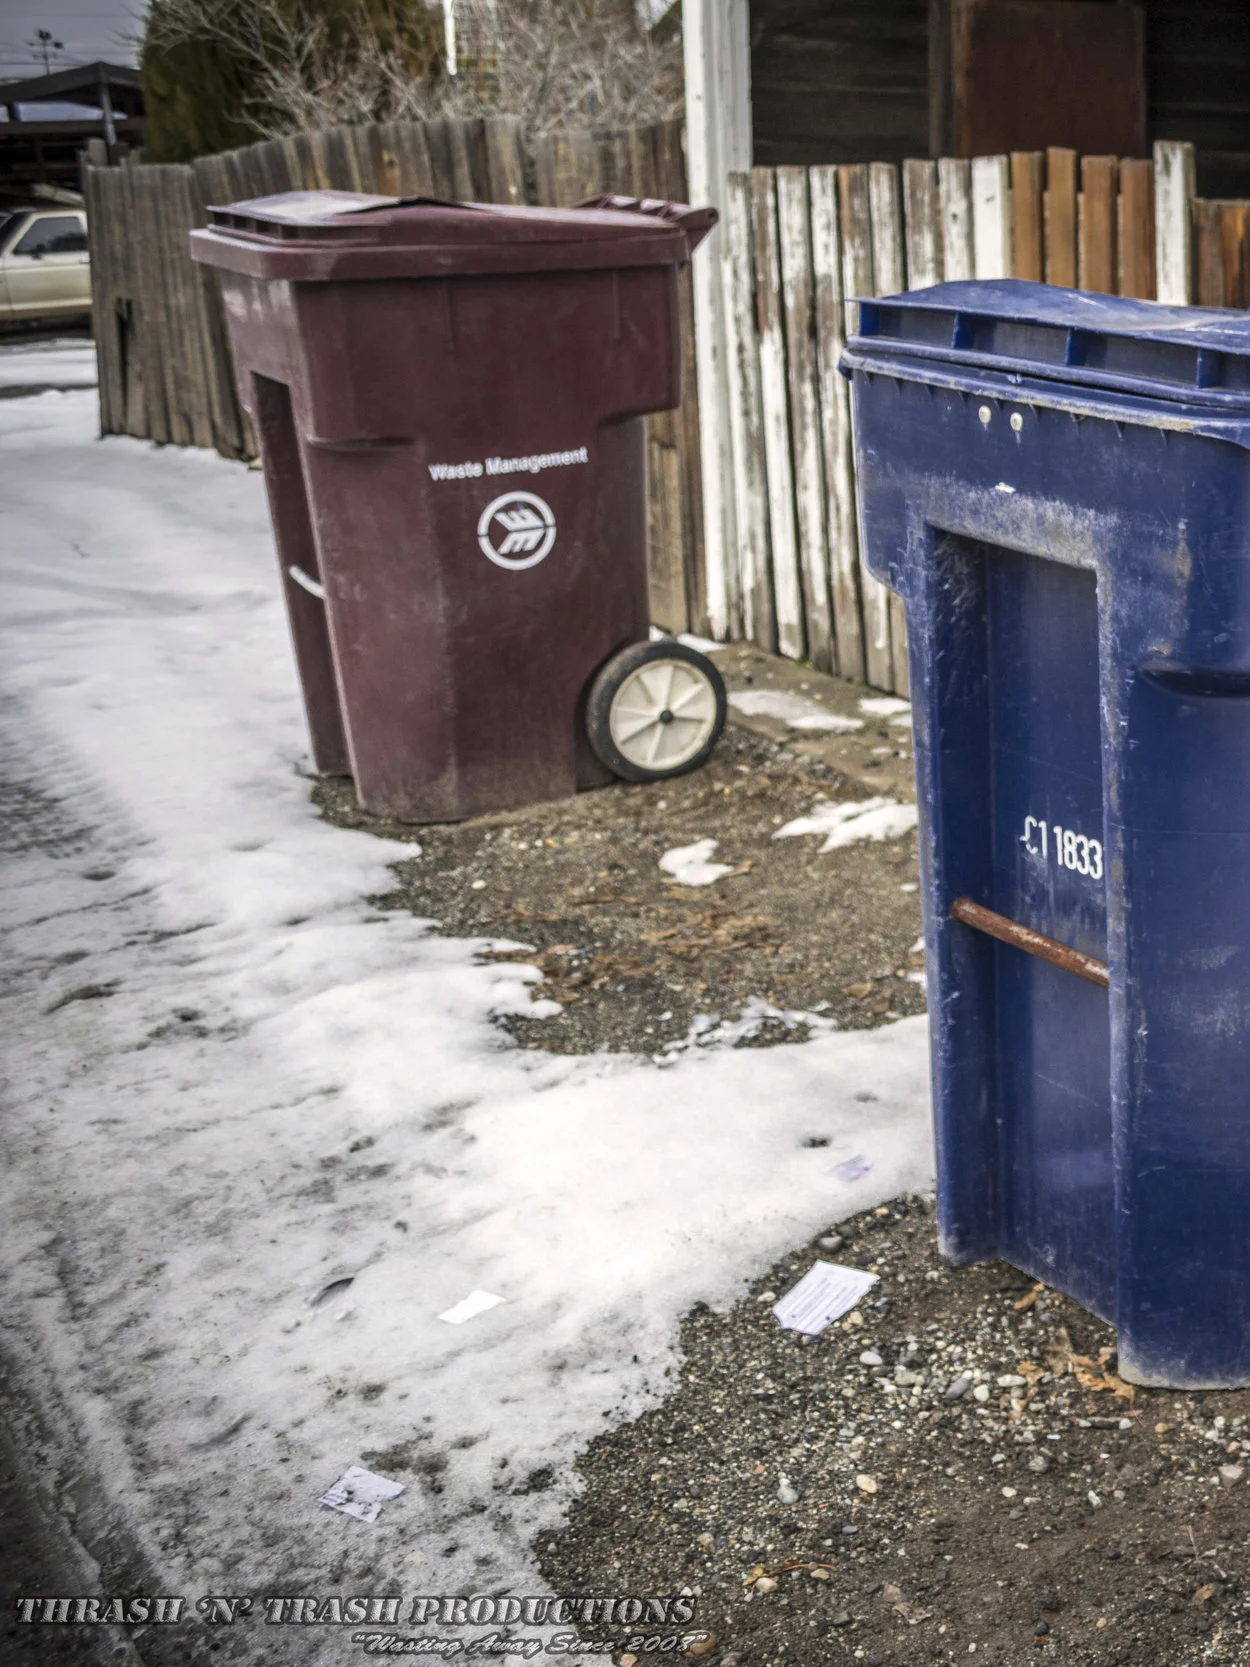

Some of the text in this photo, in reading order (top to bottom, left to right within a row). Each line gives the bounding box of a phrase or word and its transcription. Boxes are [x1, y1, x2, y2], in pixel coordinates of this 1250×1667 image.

[428, 446, 588, 480] Waste Management
[1052, 825, 1103, 880] 1833
